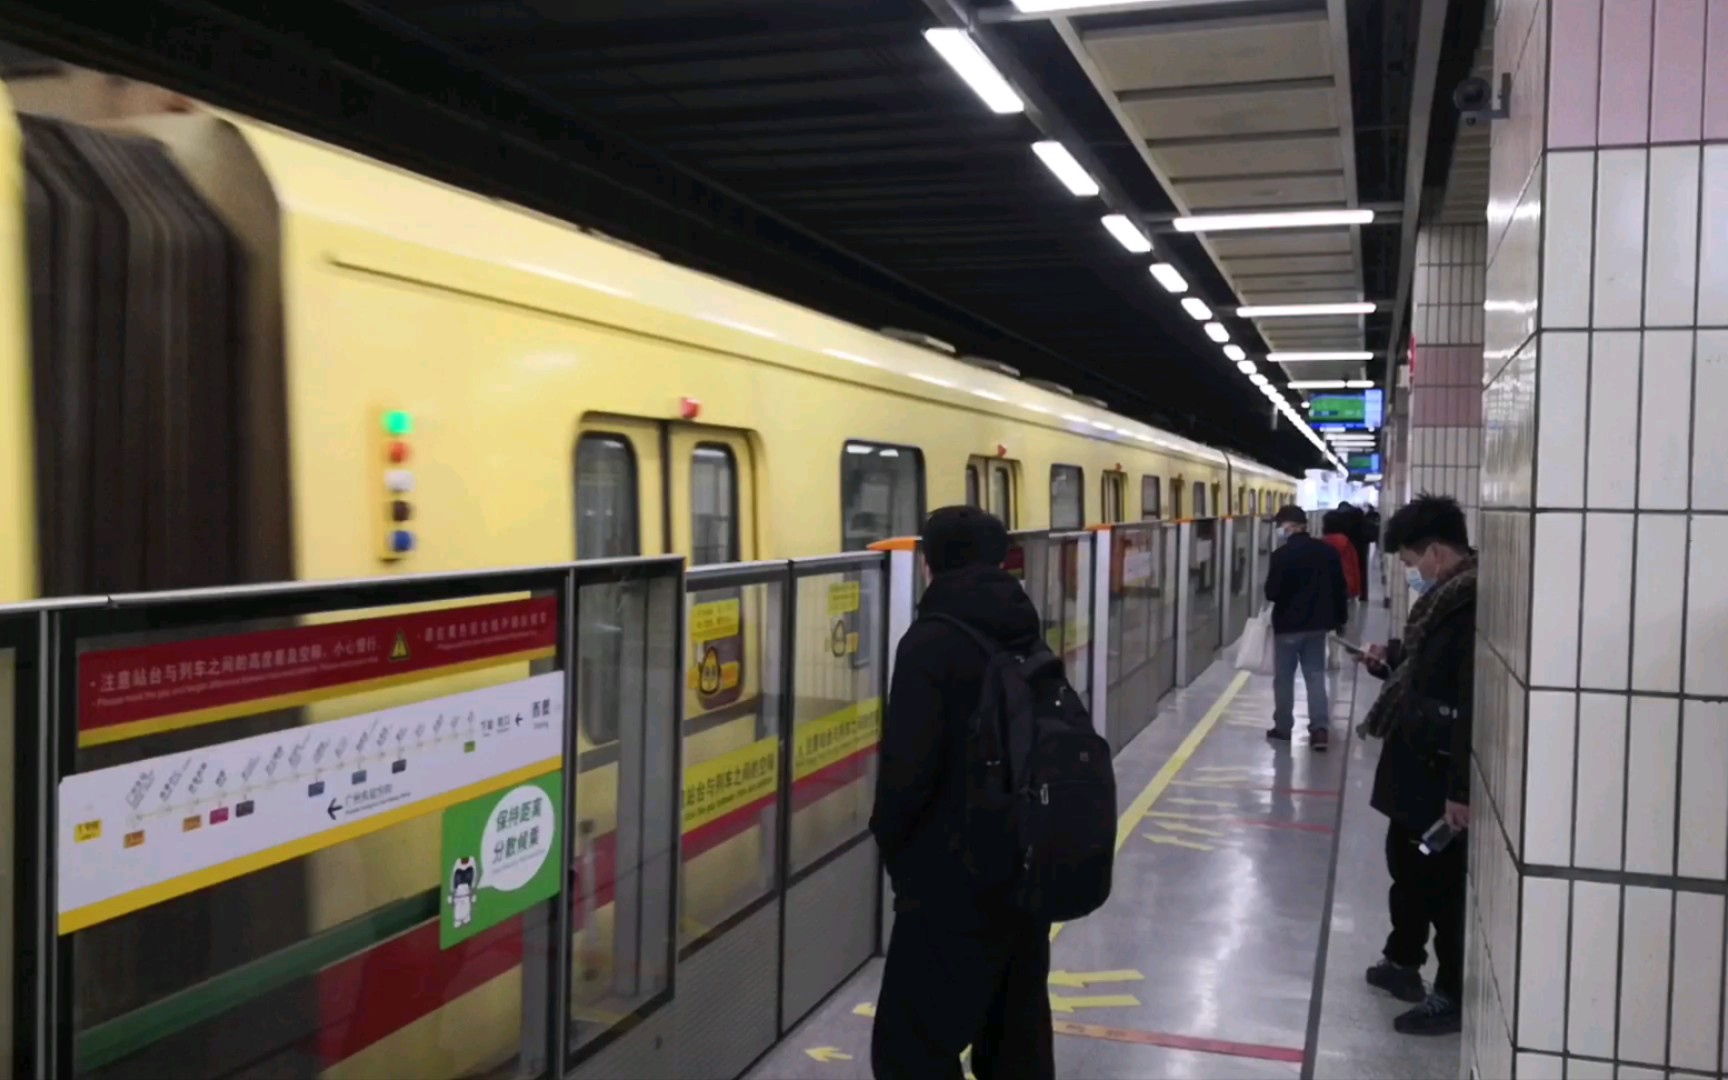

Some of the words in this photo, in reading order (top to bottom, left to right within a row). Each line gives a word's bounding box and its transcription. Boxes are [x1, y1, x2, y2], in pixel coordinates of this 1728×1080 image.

[682, 753, 774, 808] 站台与列车之间的空隙
[496, 797, 543, 833] 保持距离
